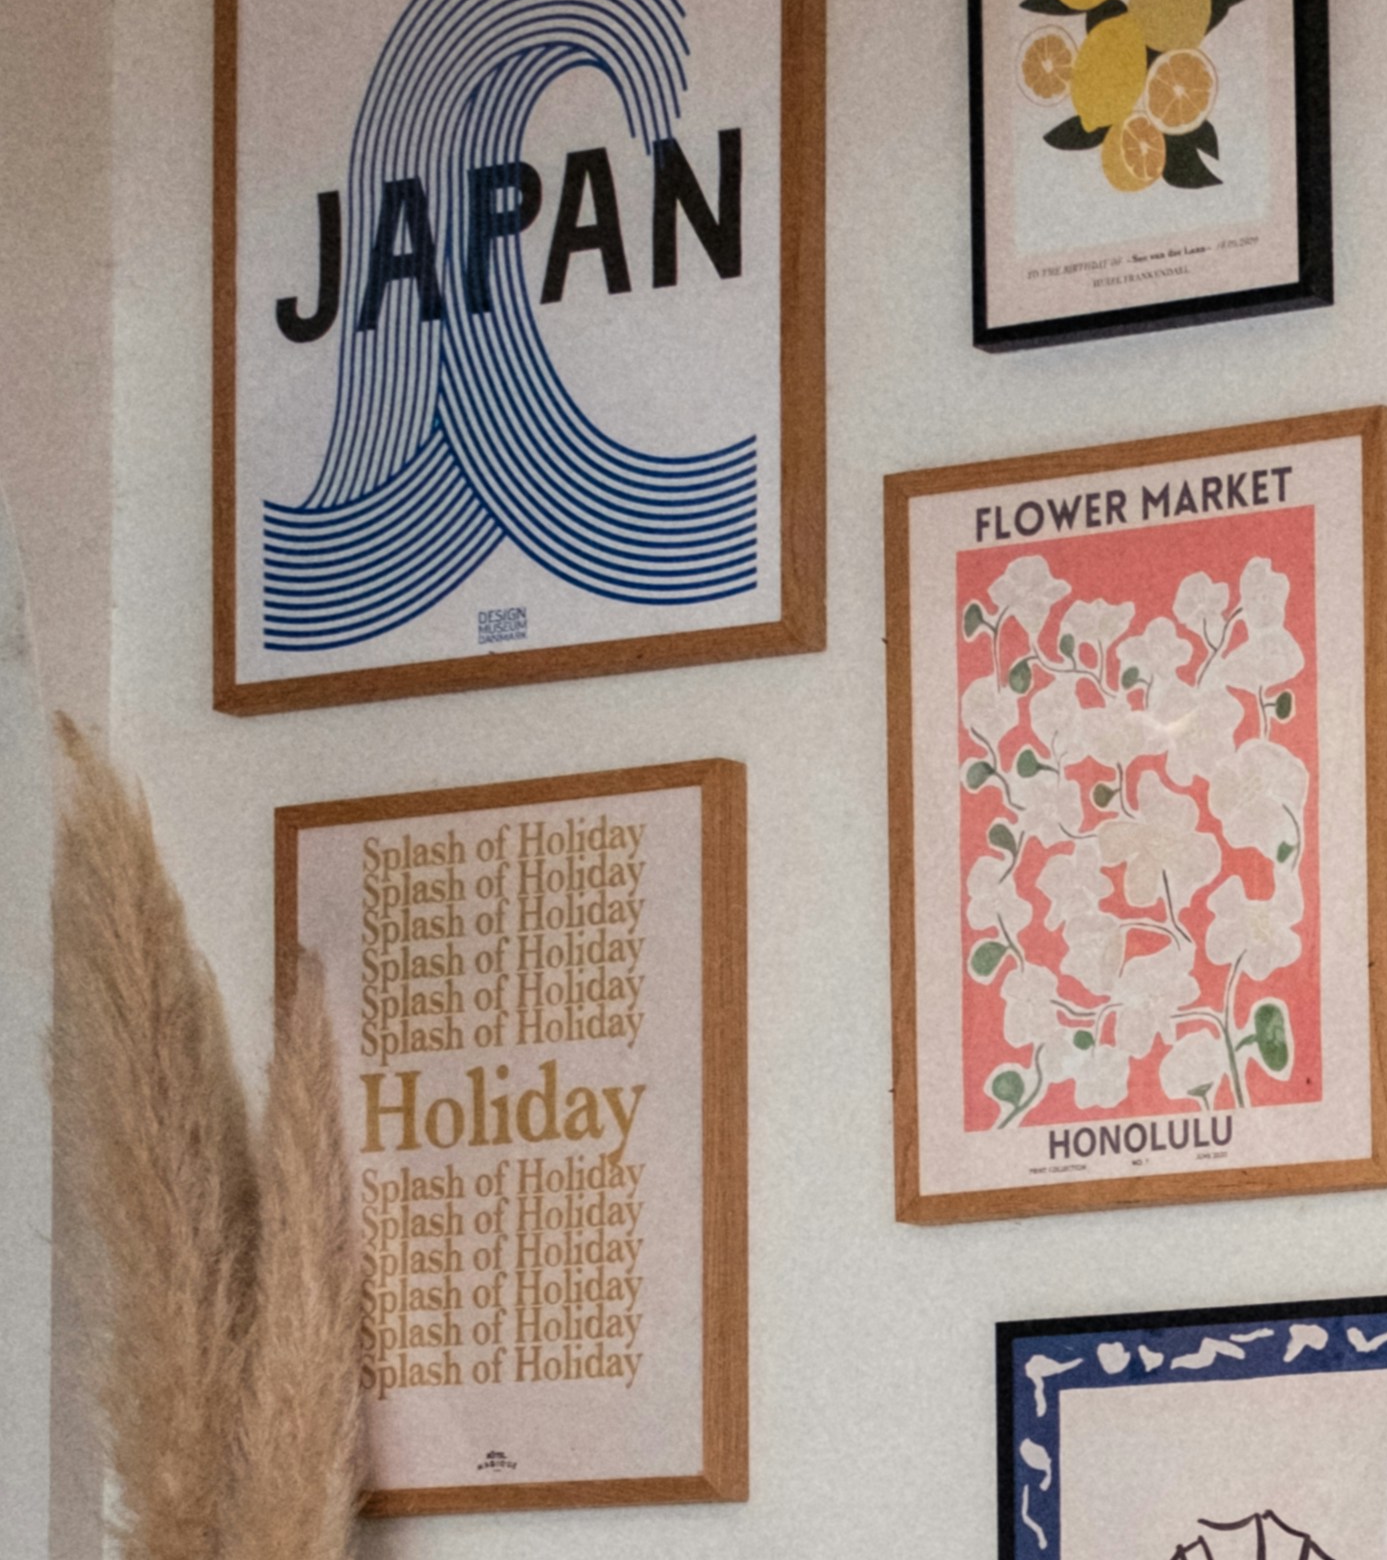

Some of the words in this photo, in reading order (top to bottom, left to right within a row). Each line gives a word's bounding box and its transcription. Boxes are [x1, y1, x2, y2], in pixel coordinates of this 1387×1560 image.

[274, 127, 743, 344] JAPAN
[974, 488, 1129, 543] FLOWER
[1141, 466, 1293, 522] MARKET
[478, 607, 527, 624] DESIGN
[363, 829, 466, 882] Splash
[476, 823, 510, 861] of
[517, 814, 646, 860] Holiday
[363, 867, 466, 920] Splash
[475, 861, 510, 899] of
[517, 851, 646, 897] Holiday
[360, 1059, 646, 1167] Holiday
[1048, 1115, 1233, 1160] HONOLULU
